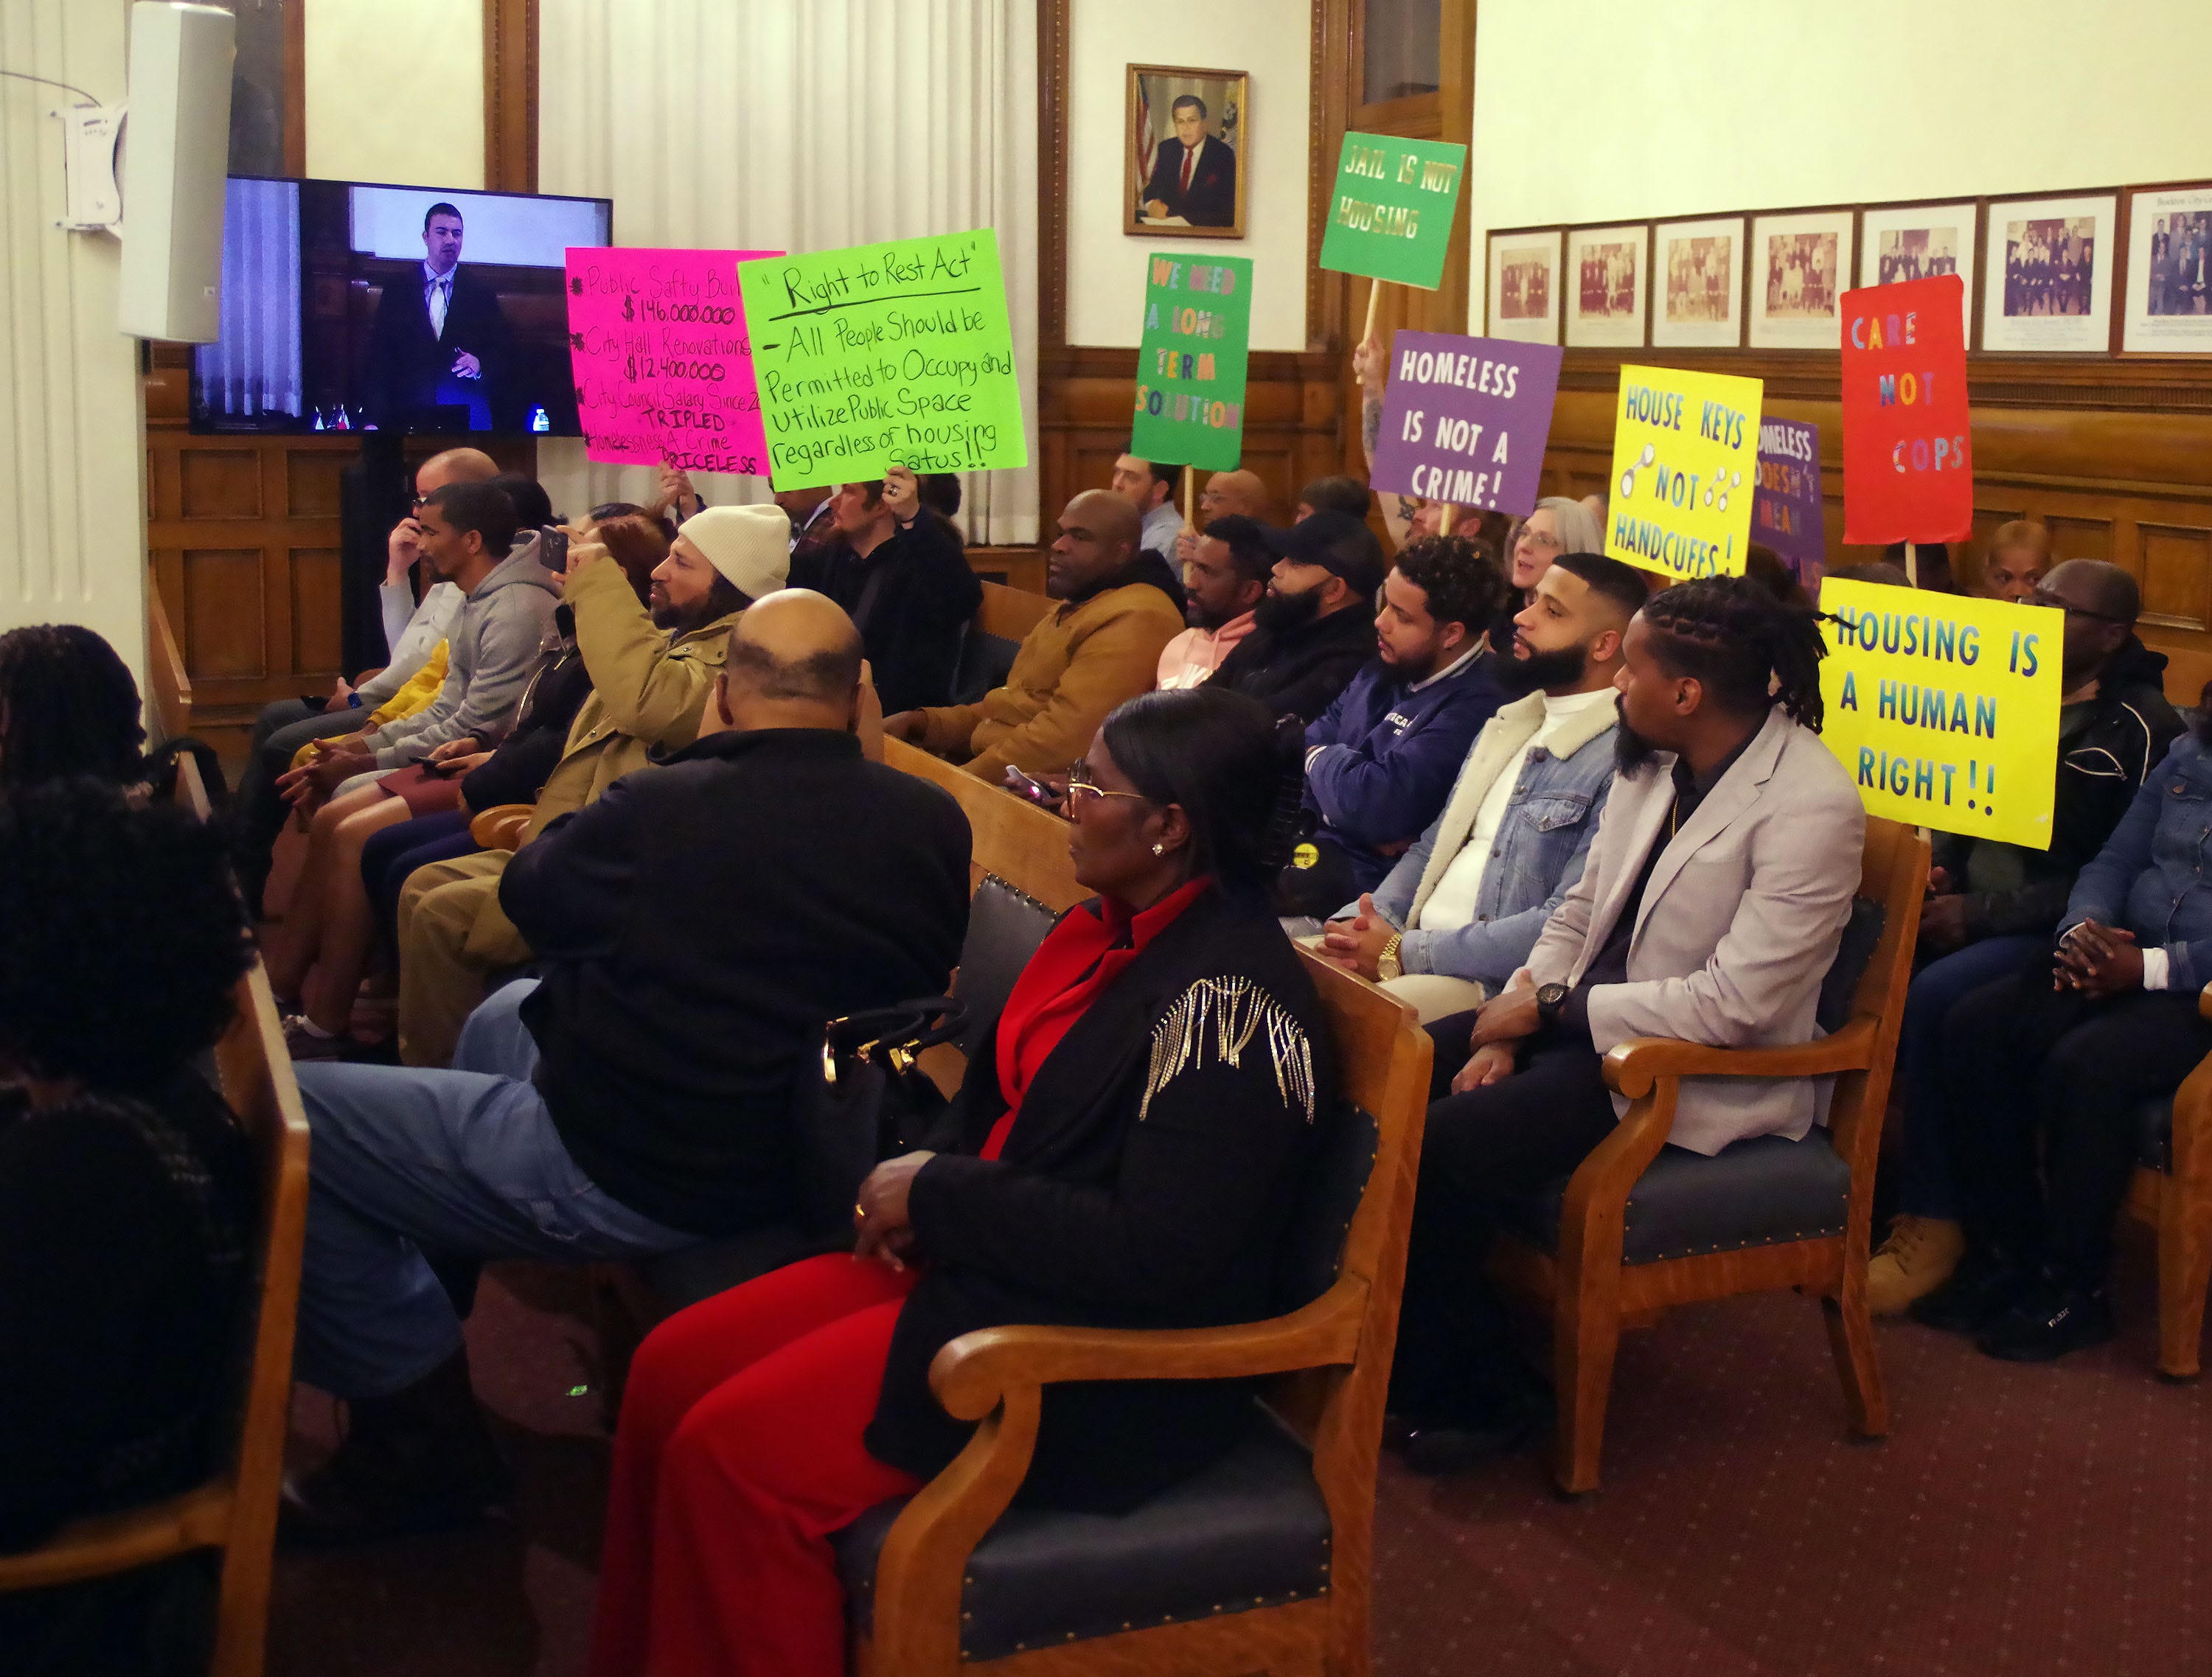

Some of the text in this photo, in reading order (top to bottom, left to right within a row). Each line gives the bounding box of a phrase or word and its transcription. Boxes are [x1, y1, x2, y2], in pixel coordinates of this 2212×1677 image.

[1346, 145, 1457, 194] JAIL IS NOT
[1338, 196, 1419, 239] HOUSING
[587, 265, 742, 304] Public Safty Buil
[858, 263, 878, 287] to
[884, 251, 925, 285] Rest
[1152, 258, 1181, 290] WE
[786, 326, 824, 363] All
[833, 317, 884, 354] People
[887, 307, 957, 341] Should
[961, 307, 986, 332] be
[1146, 304, 1159, 330] A
[1851, 311, 1916, 350] CARE
[585, 326, 620, 362] City
[625, 332, 651, 355] Hall
[1157, 348, 1216, 380] TERM
[765, 349, 1012, 405] Permitted to Occupy and
[1399, 349, 1519, 399] HOMELESS
[1879, 372, 1934, 406] NOT
[583, 378, 618, 419] City
[617, 379, 660, 408] Council
[664, 381, 704, 412] Salary
[706, 383, 745, 411] Since
[641, 407, 725, 432] TRIPLED
[848, 394, 894, 422] Public
[897, 387, 973, 419] Space
[1135, 385, 1240, 430] SOLUTION
[1626, 384, 1746, 450] HOUSE KEYS
[667, 430, 680, 451] A
[685, 429, 731, 451] Crime
[771, 433, 875, 475] regardless
[905, 419, 997, 453] housing
[1402, 410, 1508, 464] IS NOT A
[1757, 423, 1812, 462] OMELESS
[1893, 435, 1965, 473] COPS
[1411, 464, 1502, 509] CRIME!
[1655, 462, 1700, 511] NOT
[1837, 604, 2039, 677] HOUSING IS
[1840, 671, 1997, 739] A HUMAN
[1857, 745, 1995, 817] RIGHT!!
